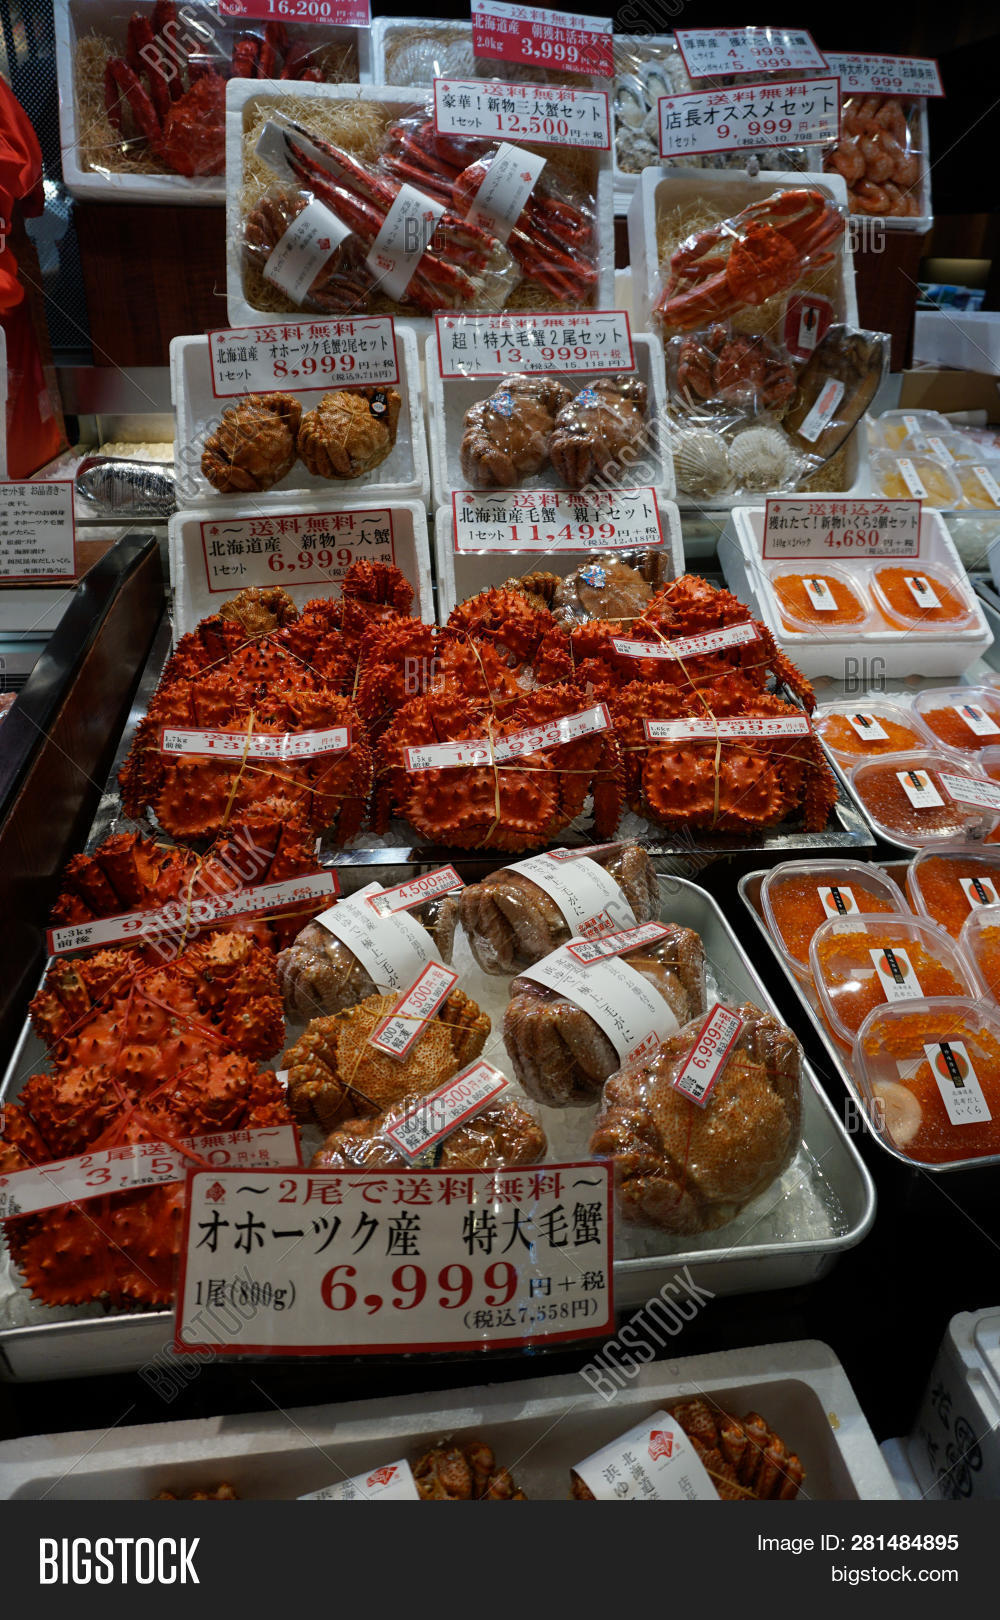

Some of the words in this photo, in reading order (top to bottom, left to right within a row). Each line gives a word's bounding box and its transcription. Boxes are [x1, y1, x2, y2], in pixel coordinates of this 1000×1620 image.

[472, 14, 520, 35] 北海道産
[532, 23, 612, 48] 朝獲れ活ホタテ
[476, 36, 504, 52] 2.0kg
[665, 96, 834, 130] 店長オススメセット
[451, 116, 482, 128] 1セット
[668, 134, 697, 148] 1セット
[217, 346, 258, 364] 北海道産
[269, 336, 388, 359] オホーツク毛蟹2尾セット
[219, 369, 251, 382] 1セット
[459, 507, 556, 524] 北海道産毛蟹
[574, 503, 652, 523] 親子セット
[208, 537, 281, 557] 北海道産
[301, 528, 391, 550] 新物二大蟹
[469, 529, 505, 542] 1セット
[213, 563, 247, 576] 1セット
[56, 927, 93, 941] 1.3kg
[57, 936, 90, 949] 前後
[955, 1105, 981, 1115] いくら
[195, 1208, 422, 1257] オホーツク産
[462, 1201, 603, 1257] 特大毛蟹
[194, 1278, 296, 1311] 1尾(800g)
